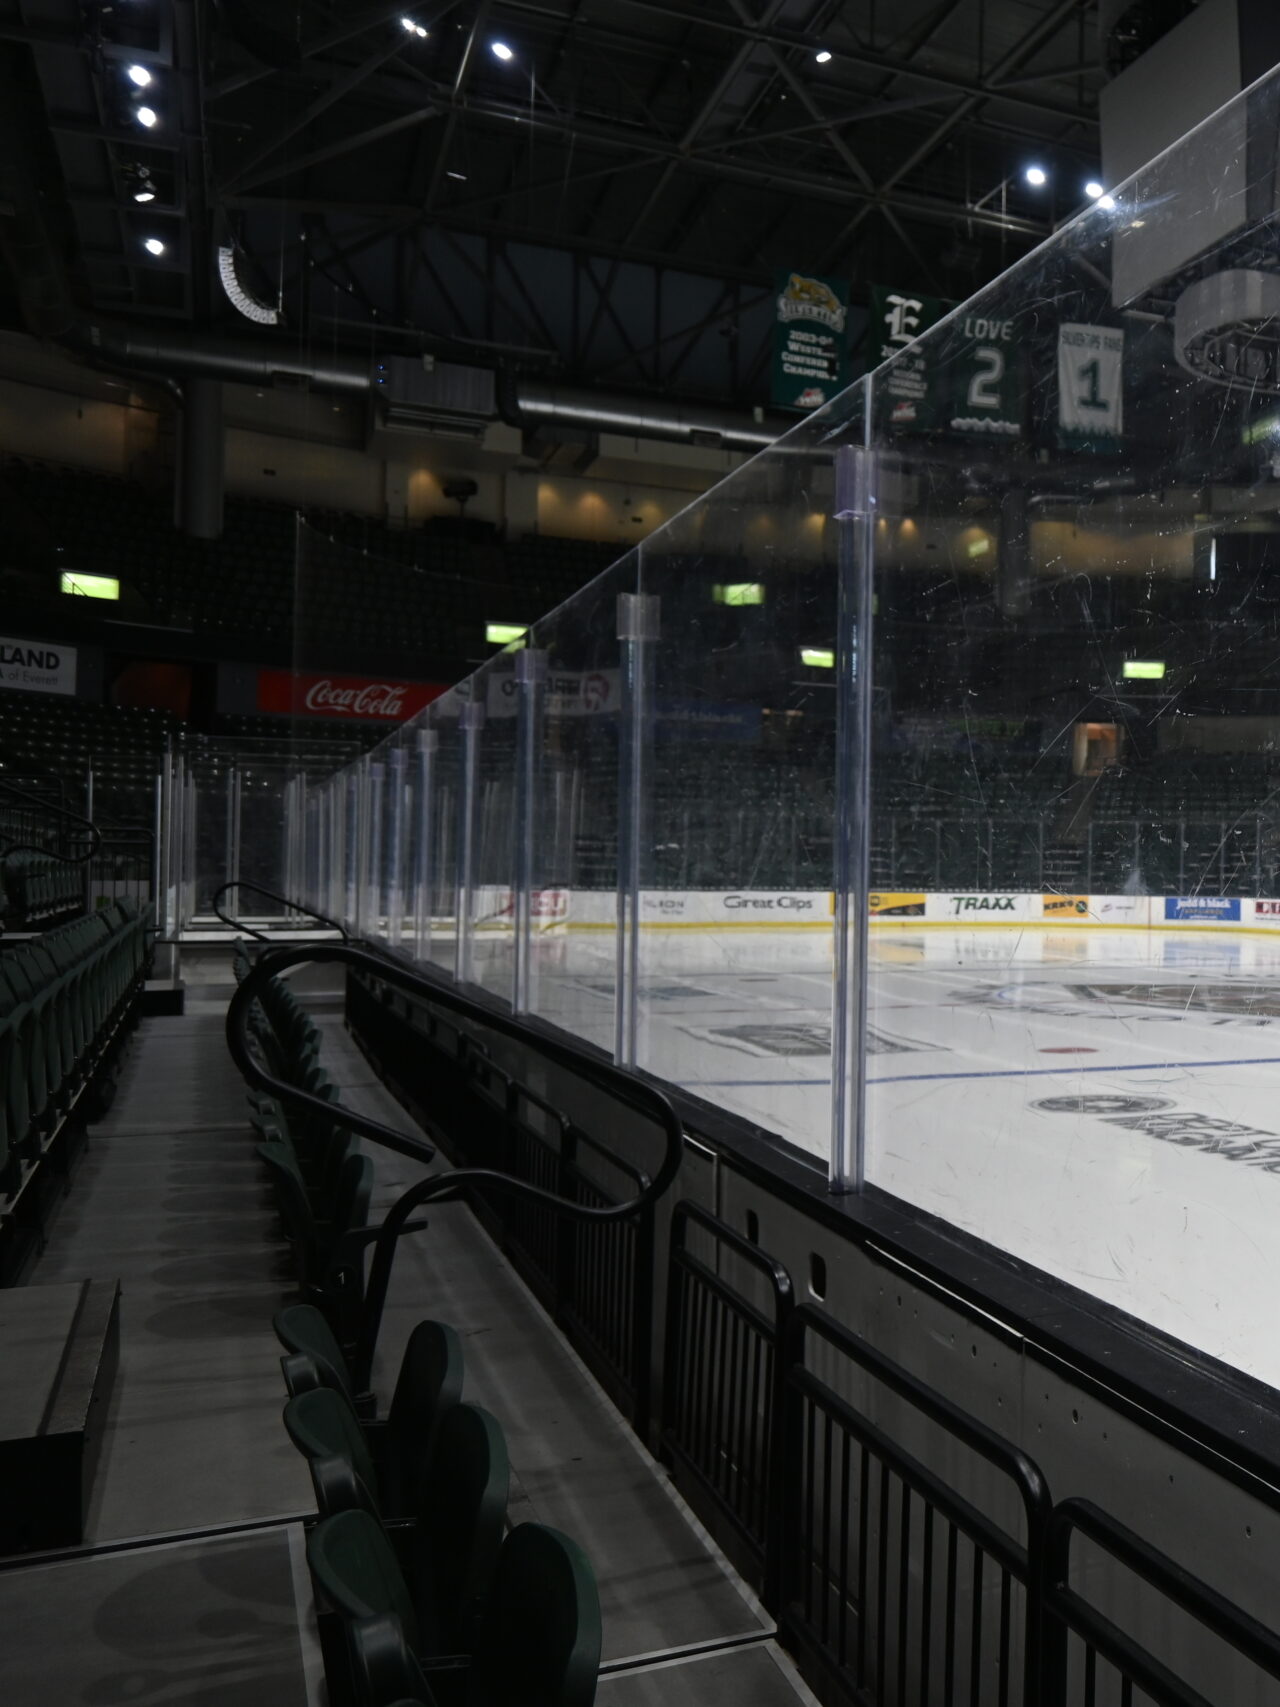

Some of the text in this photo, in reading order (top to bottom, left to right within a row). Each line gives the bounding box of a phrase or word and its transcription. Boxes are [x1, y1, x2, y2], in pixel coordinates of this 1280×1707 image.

[965, 318, 1014, 340] LOVE
[966, 346, 1005, 409] 2
[1077, 358, 1110, 412] 1
[23, 670, 58, 686] Everett
[305, 678, 408, 716] Coca-Cola
[724, 895, 812, 912] Great Clips
[952, 895, 1016, 915] TRAXX
[338, 1271, 345, 1285] 1
